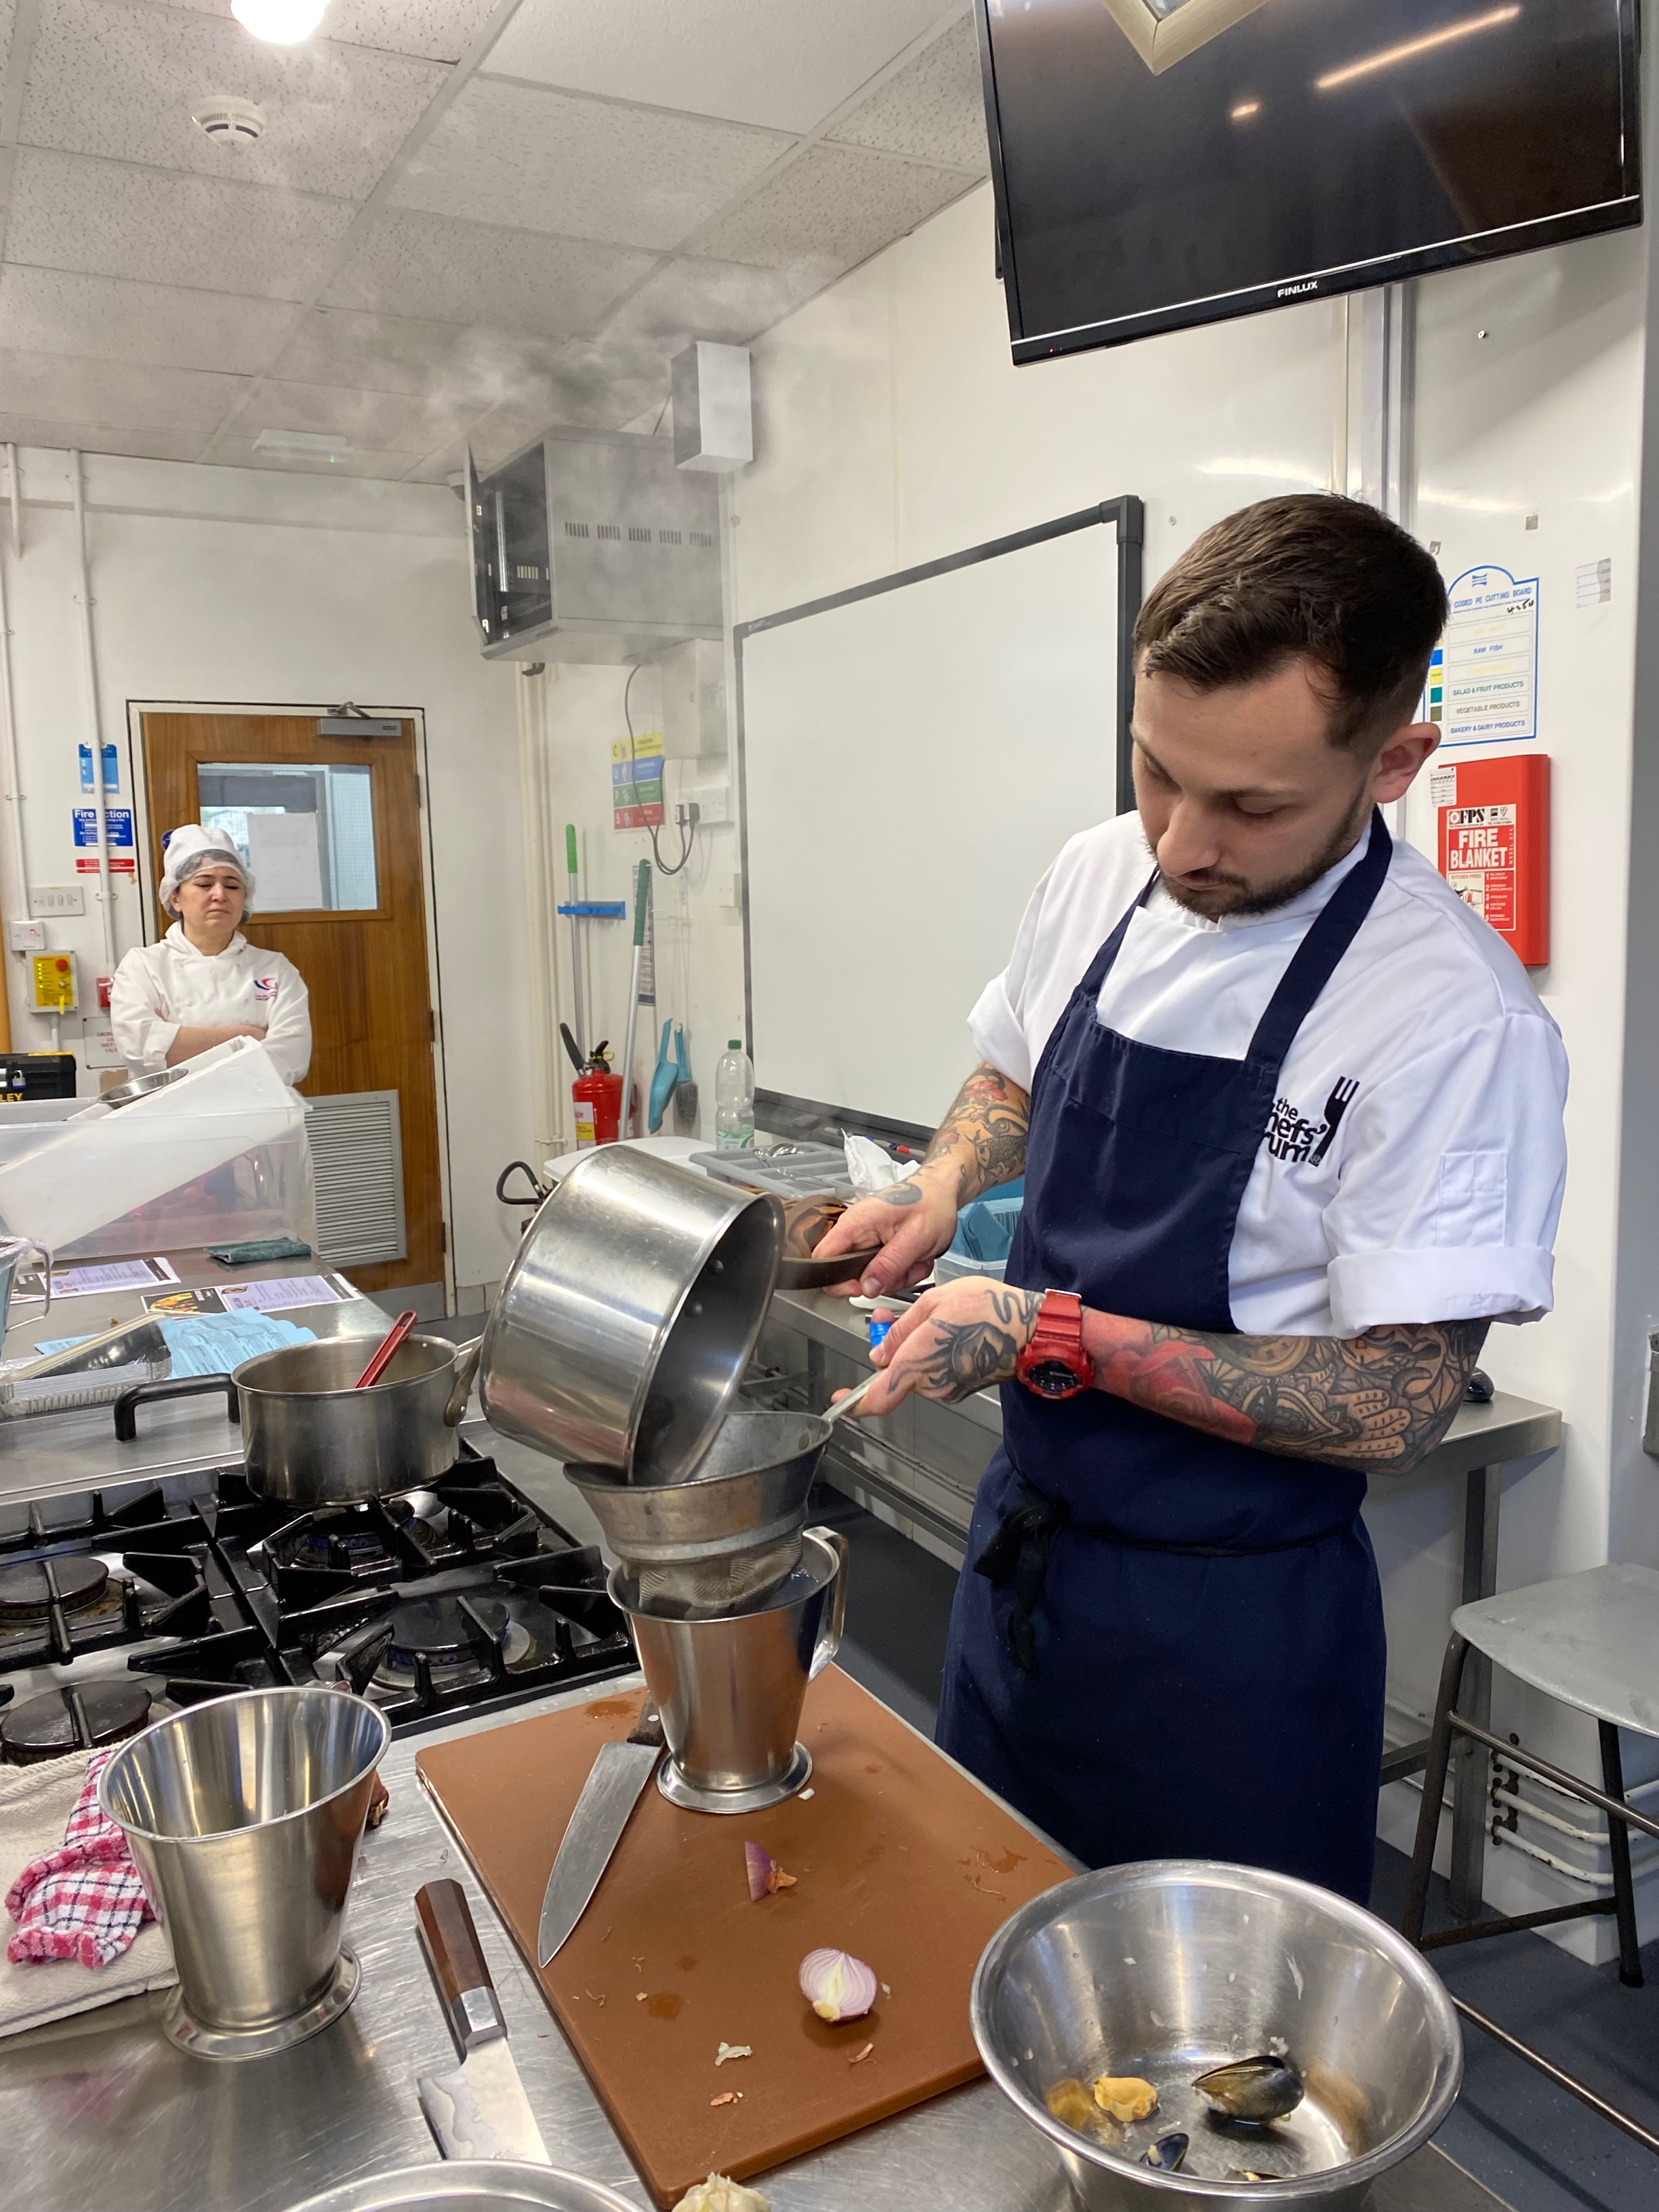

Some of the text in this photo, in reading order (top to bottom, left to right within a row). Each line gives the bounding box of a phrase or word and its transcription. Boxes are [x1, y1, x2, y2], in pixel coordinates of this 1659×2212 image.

[1277, 281, 1318, 298] FINLUX
[1454, 599, 1473, 608] CODED
[1486, 592, 1509, 602] CUTTING
[1513, 588, 1532, 597] BOARD
[1493, 681, 1523, 691] PRODUCTS
[1456, 701, 1520, 714] VEGETABLE PRODUCTS
[74, 810, 129, 819] Fire ction
[1460, 808, 1485, 823] FPS
[1459, 828, 1498, 848] FIRE
[1450, 846, 1508, 869] BLANKET
[0, 1092, 23, 1102] LEY
[1276, 1098, 1298, 1120] the
